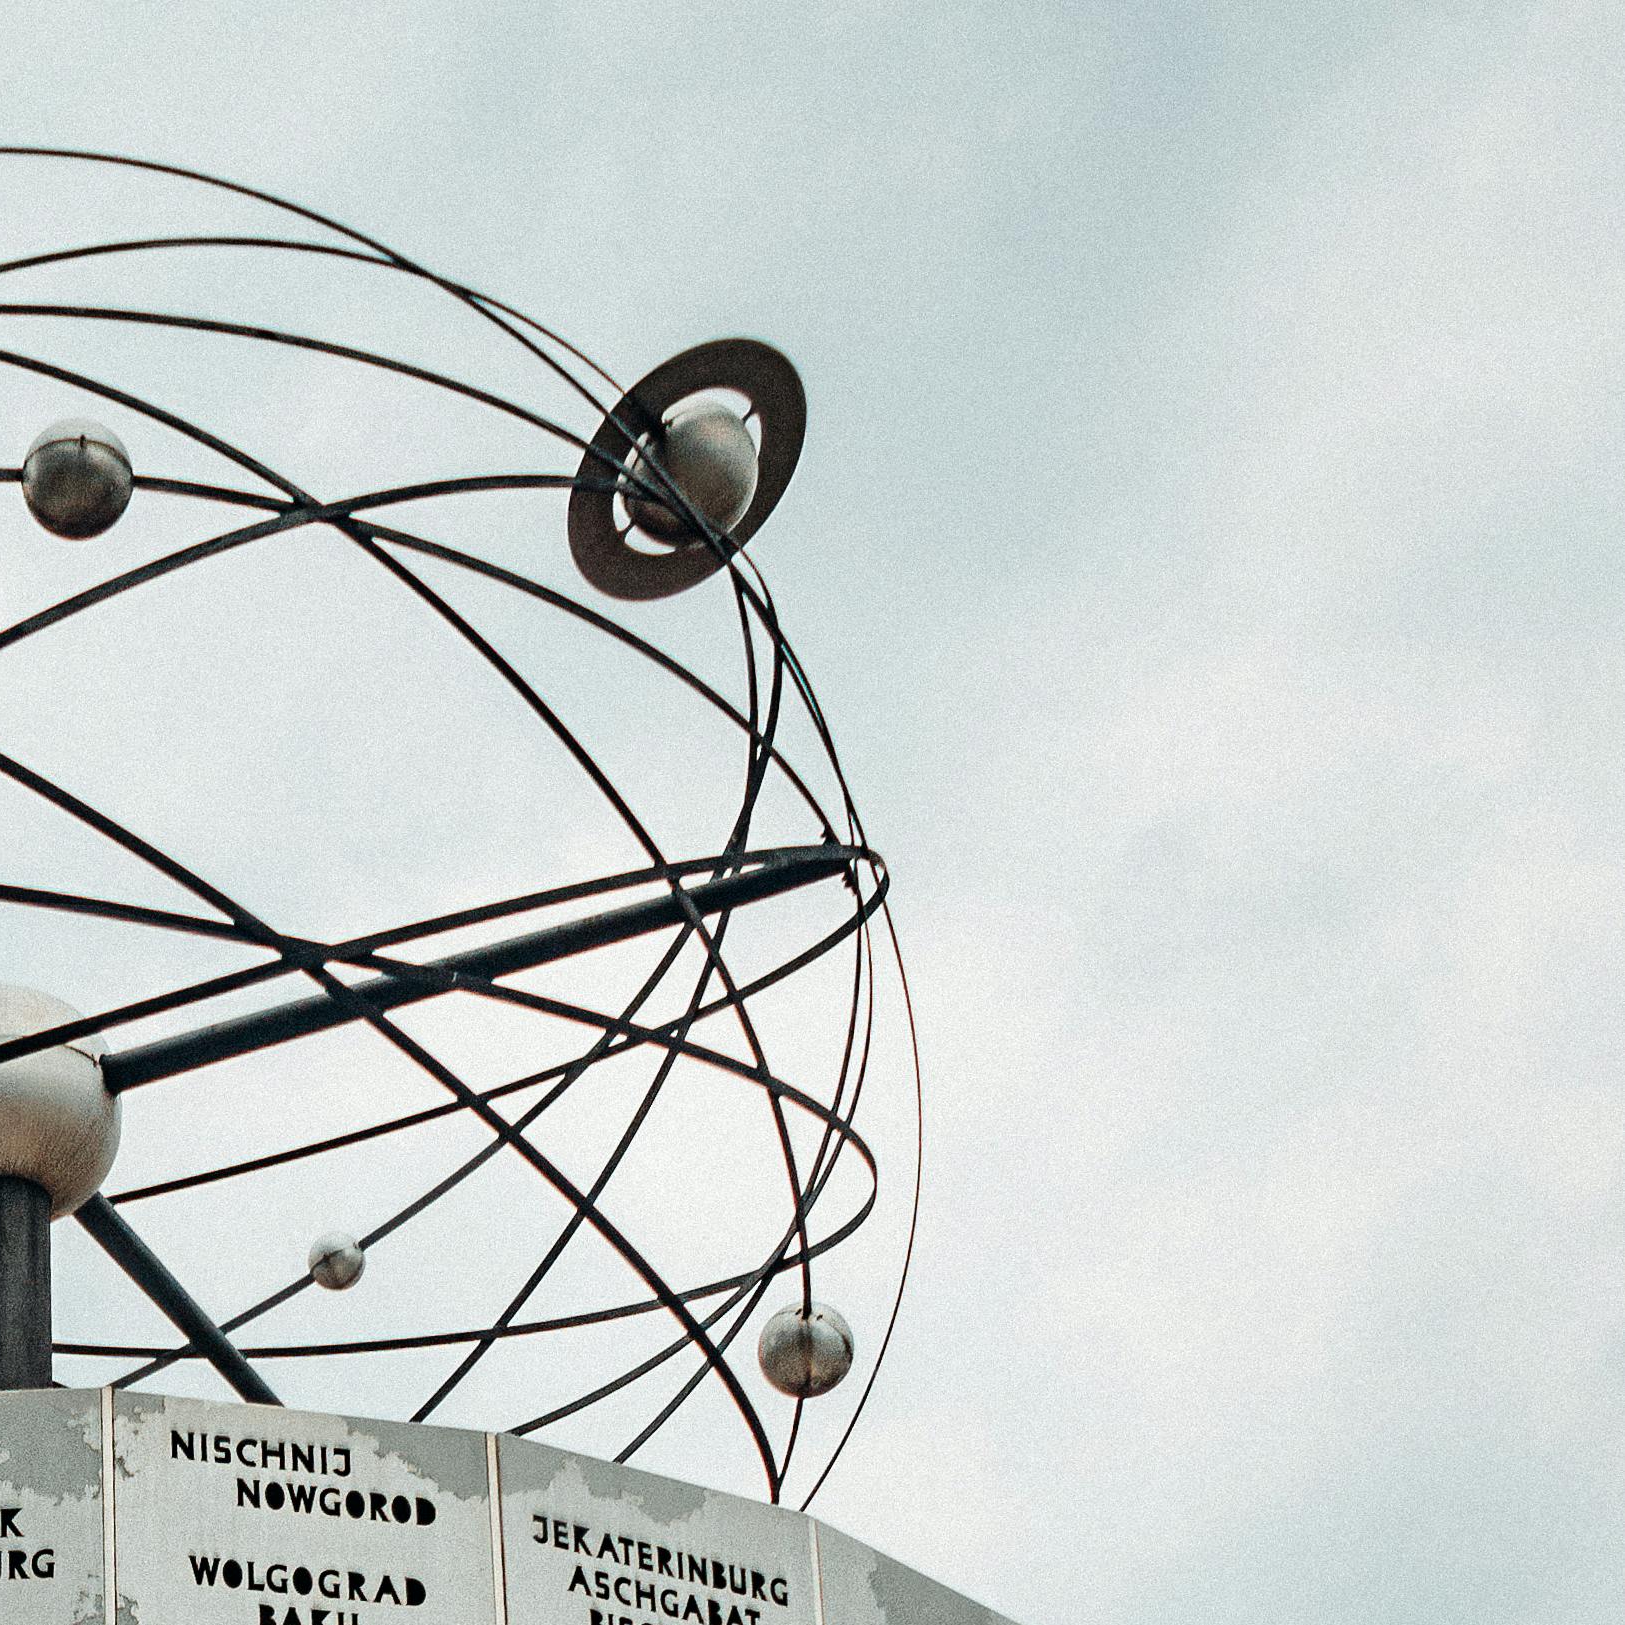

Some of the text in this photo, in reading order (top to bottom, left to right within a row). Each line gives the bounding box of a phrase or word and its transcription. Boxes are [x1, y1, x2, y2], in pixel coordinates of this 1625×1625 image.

[171, 1430, 351, 1477] NISCHNIJ
[237, 1478, 436, 1526] NOWGOROD
[189, 1555, 426, 1606] WOLGOGRAD
[533, 1514, 788, 1607] JEKATERINBURG
